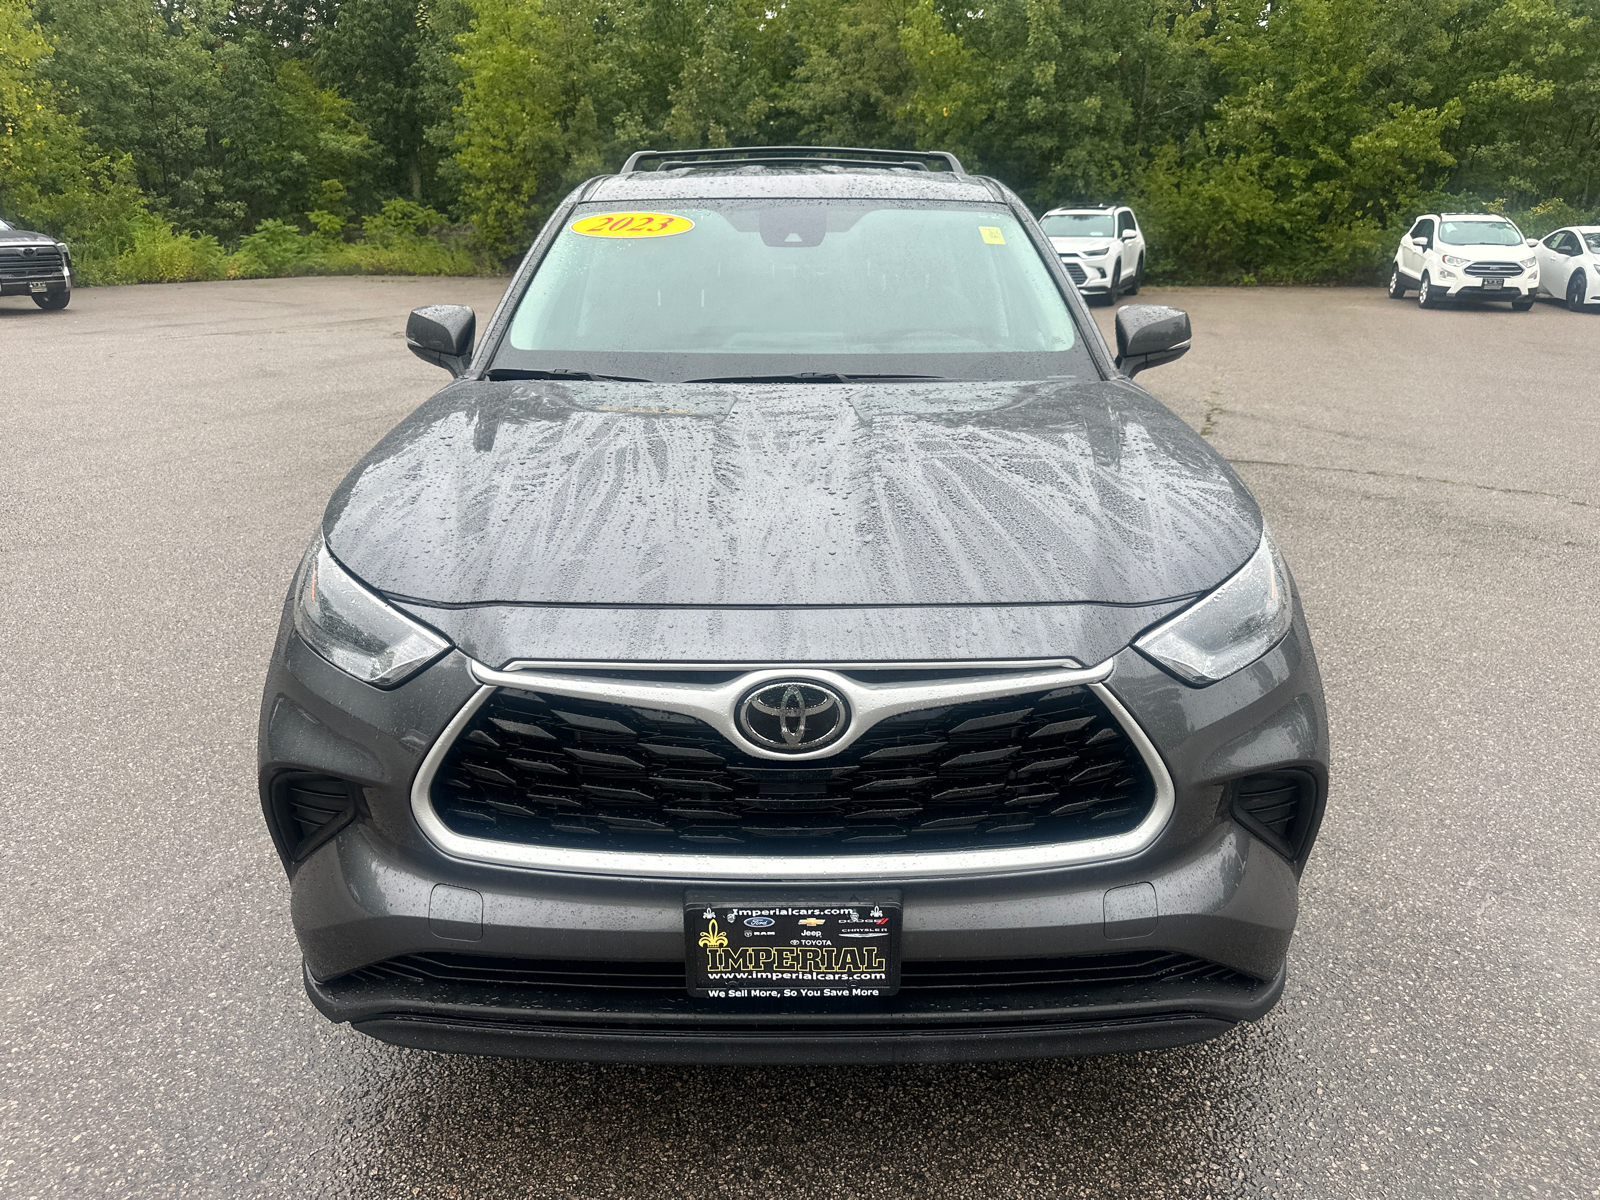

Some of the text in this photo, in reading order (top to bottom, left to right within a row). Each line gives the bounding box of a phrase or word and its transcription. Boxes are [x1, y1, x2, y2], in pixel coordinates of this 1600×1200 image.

[586, 216, 675, 232] 2023
[732, 907, 853, 917] Imperialcars.com
[801, 929, 822, 938] Jeep
[707, 947, 886, 972] IMPERIAL
[707, 971, 886, 981] www.imperialcars.com
[708, 988, 880, 998] We Sell More, So You Save More
